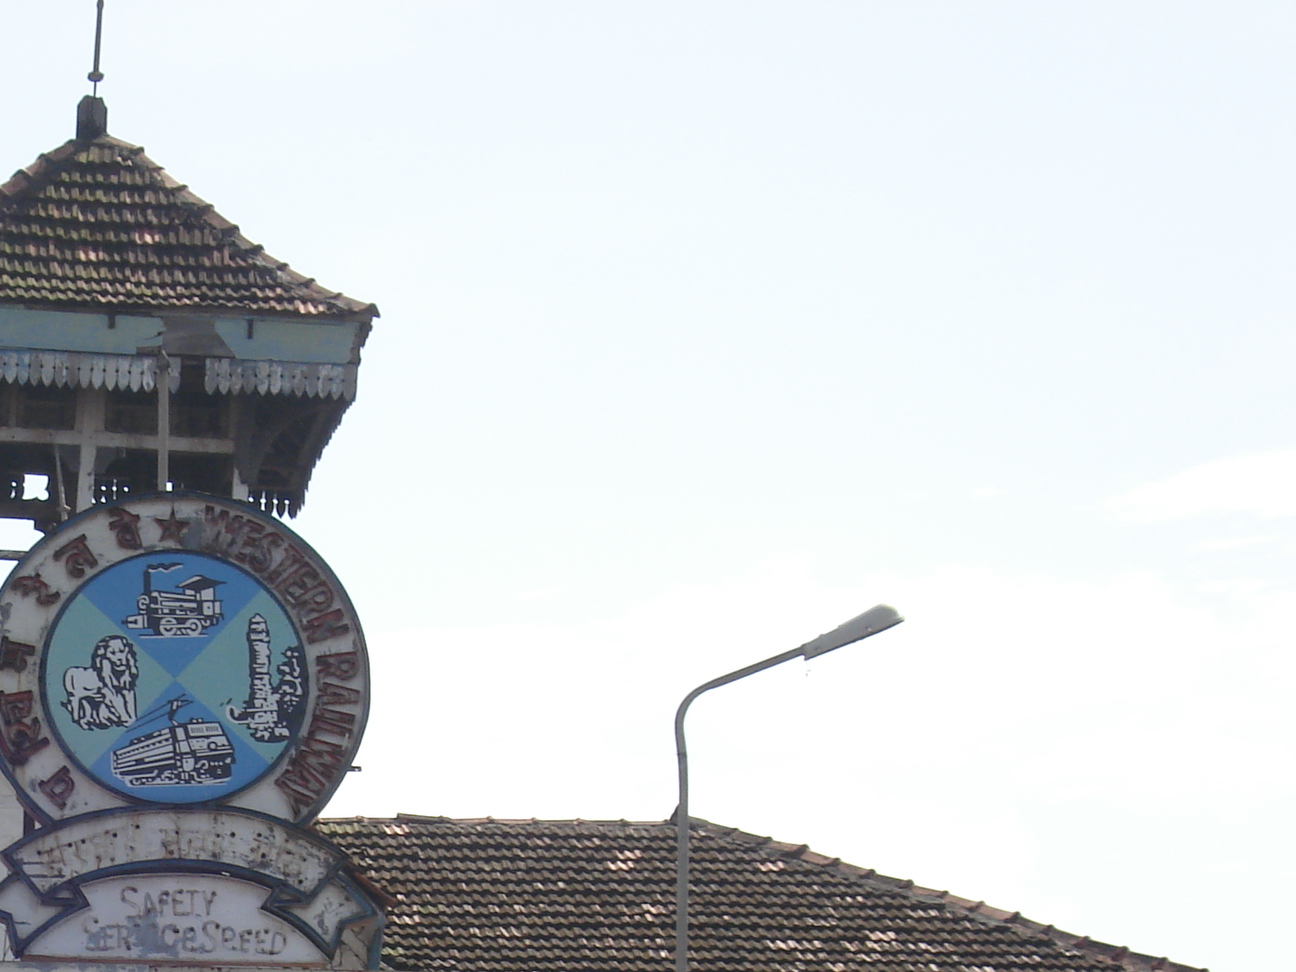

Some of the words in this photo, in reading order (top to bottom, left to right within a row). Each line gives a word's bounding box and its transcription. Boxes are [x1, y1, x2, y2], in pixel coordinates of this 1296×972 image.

[205, 504, 350, 645] WESTERN
[274, 651, 361, 821] RAILWAY
[82, 916, 198, 952] SERCE
[120, 886, 217, 918] SAFETY
